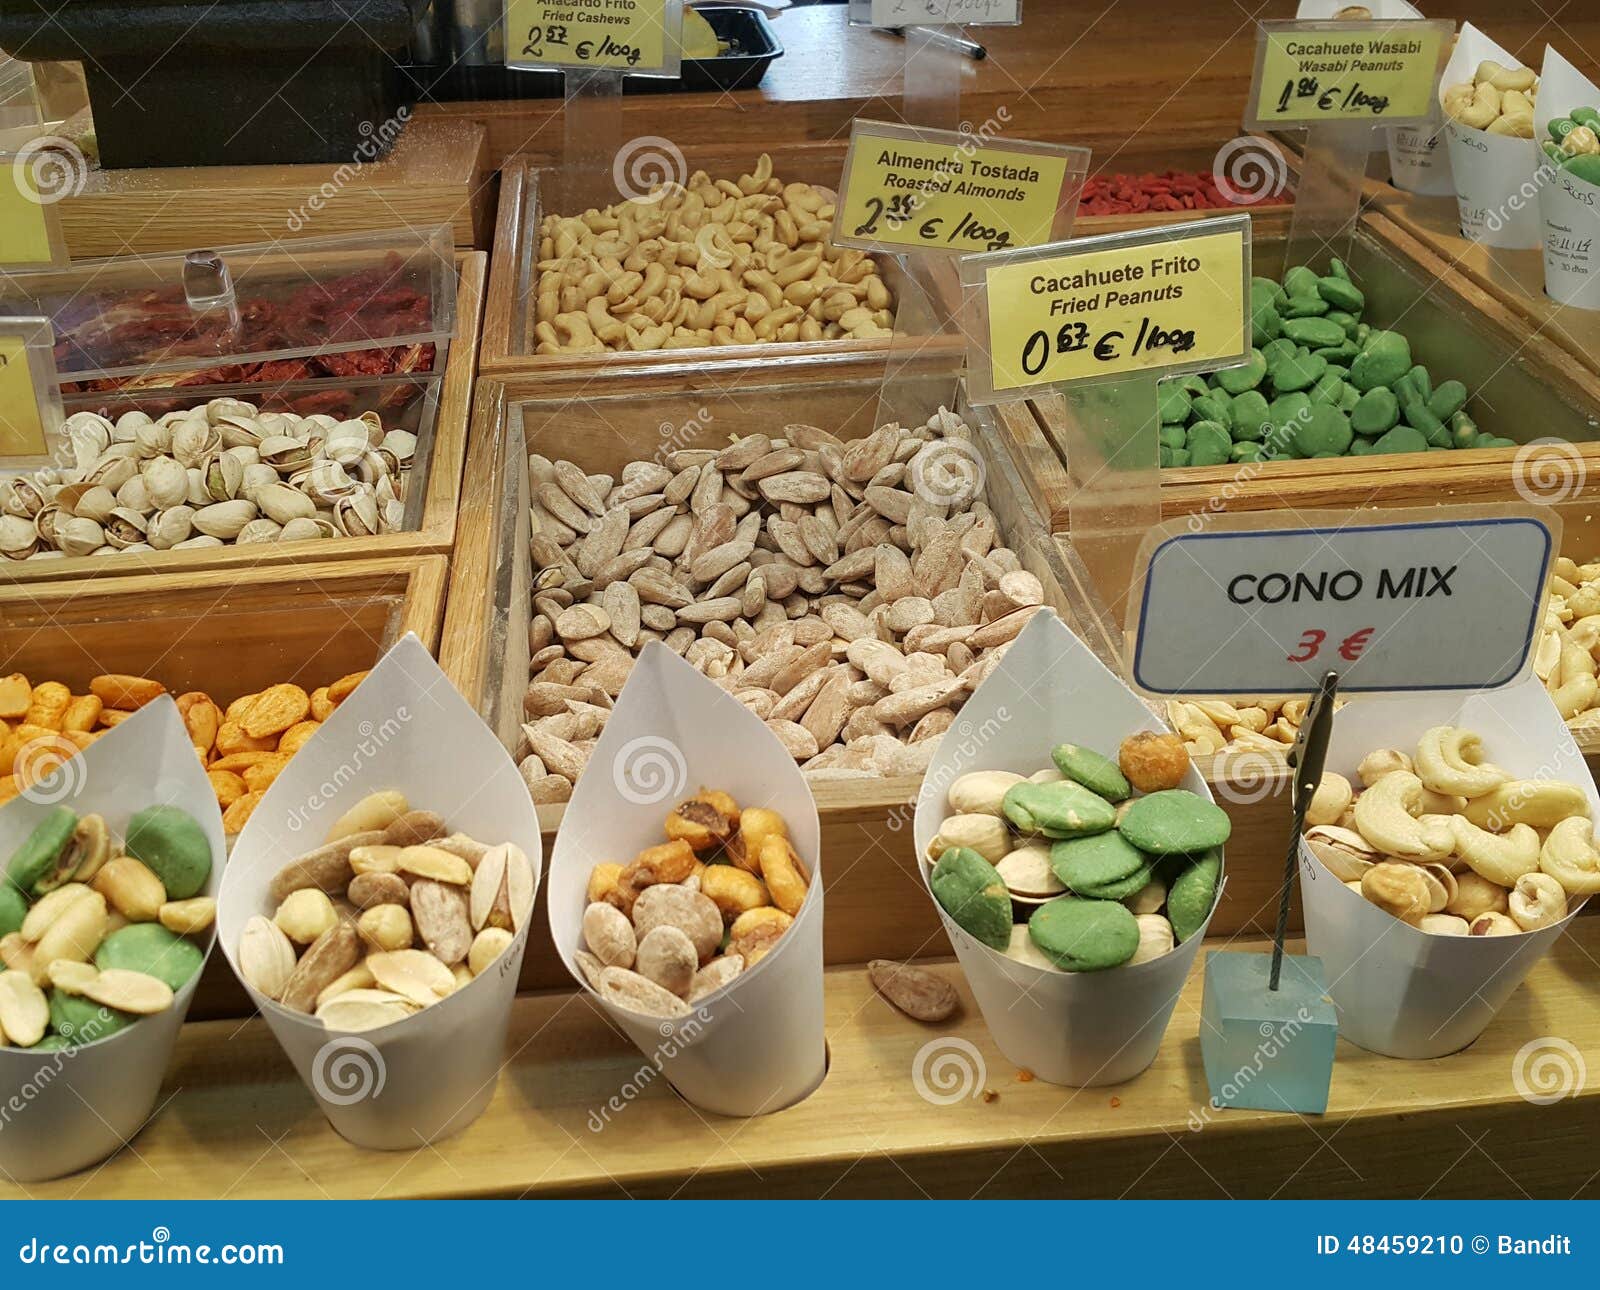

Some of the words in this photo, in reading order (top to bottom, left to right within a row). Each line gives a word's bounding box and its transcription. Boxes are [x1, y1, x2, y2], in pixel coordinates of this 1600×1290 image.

[542, 10, 573, 22] Fried
[577, 12, 631, 25] Cashews
[1286, 42, 1364, 55] Cacahuete
[1369, 40, 1421, 54] Wasabi
[1298, 60, 1348, 72] Wasabi
[1350, 60, 1404, 72] Peanuts
[877, 150, 963, 174] Almendra
[970, 160, 1040, 183] Tostada
[884, 173, 952, 193] Roasted
[954, 181, 1026, 201] Almonds
[1030, 264, 1144, 295] Cacahuete
[1151, 255, 1201, 277] Frito
[1049, 293, 1100, 317] Fried
[1104, 283, 1183, 309] Peanuts
[1227, 570, 1364, 605] CONO
[1376, 564, 1458, 600] MIX
[1286, 628, 1328, 663] 3
[1337, 627, 1376, 661] €
